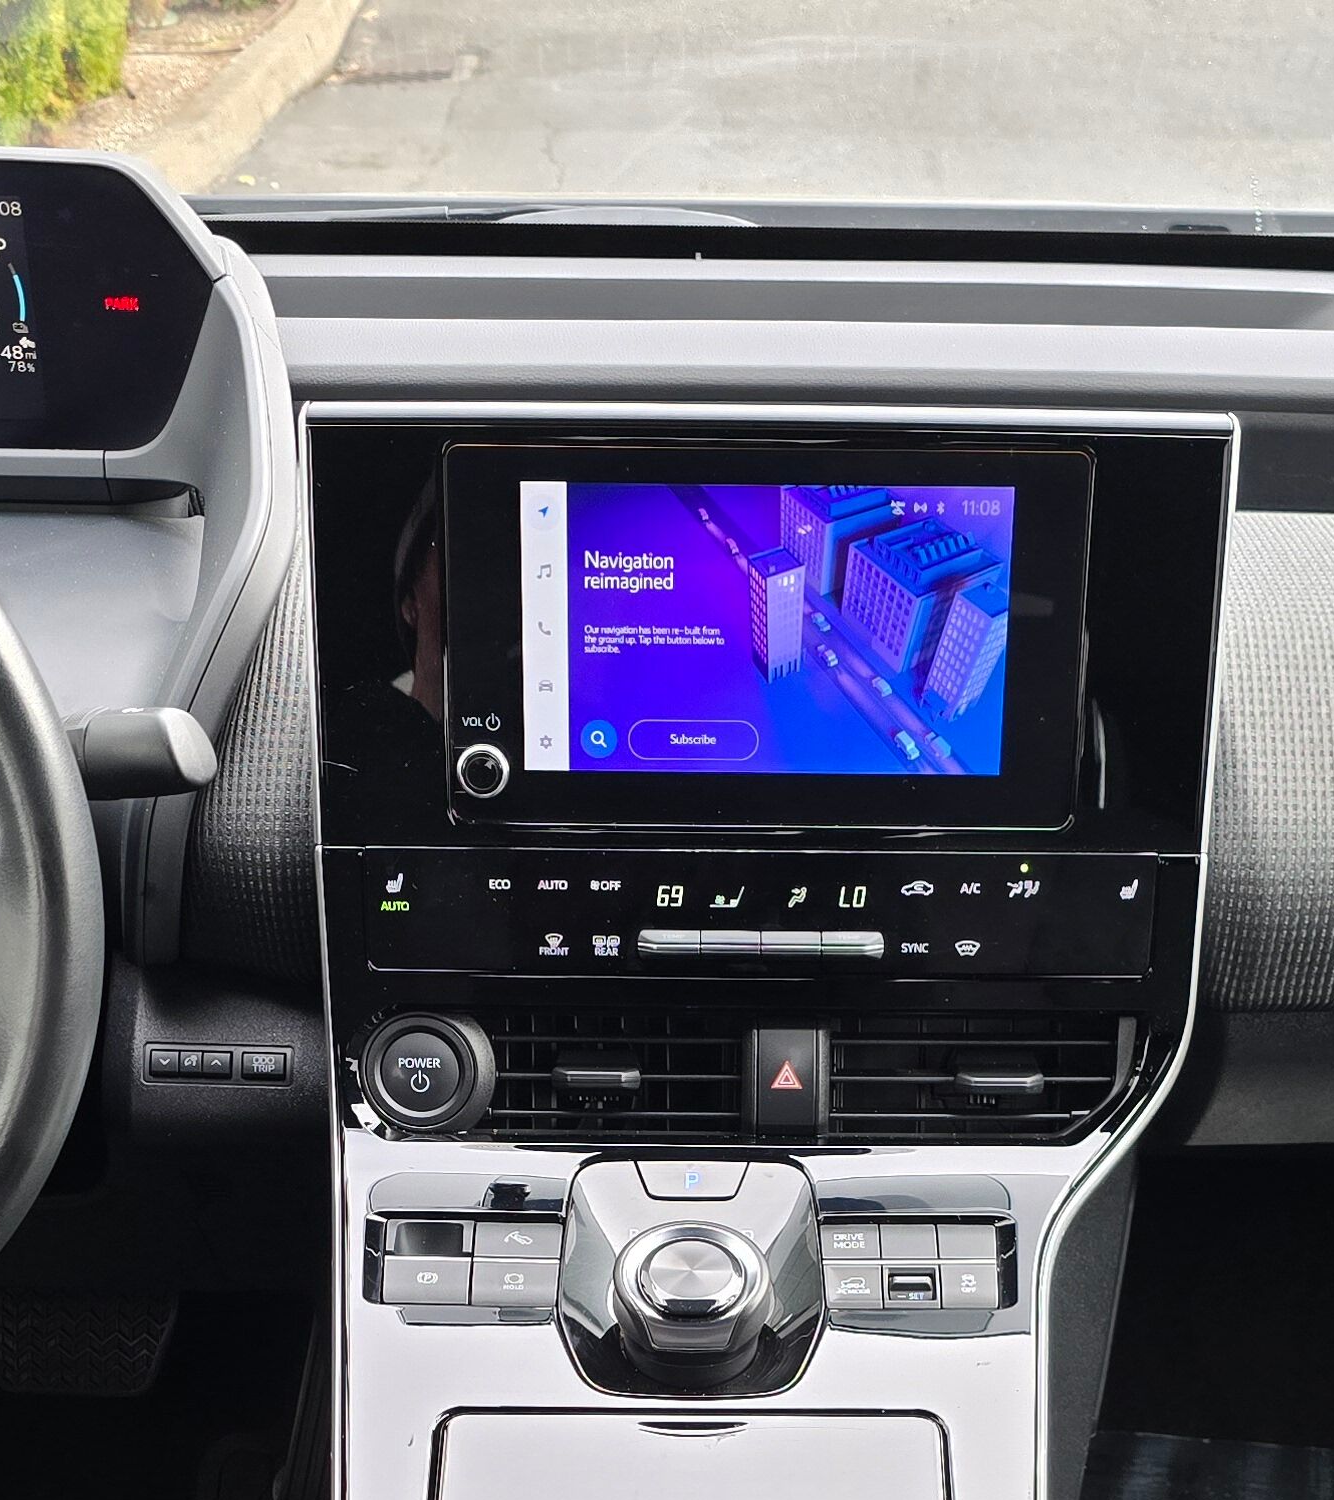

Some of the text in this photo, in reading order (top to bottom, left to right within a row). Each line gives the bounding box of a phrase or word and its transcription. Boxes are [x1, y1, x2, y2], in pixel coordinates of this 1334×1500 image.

[25, 350, 37, 360] mi
[8, 361, 35, 373] 78%
[961, 498, 1001, 517] 11:08
[584, 550, 674, 573] Navigation
[584, 572, 674, 593] reimagined
[584, 625, 720, 637] Our navigation has been re-built from
[584, 635, 725, 646] the ground up. Tap the button below to
[584, 644, 620, 654] subscribe.
[462, 716, 482, 727] VOL
[669, 733, 717, 745] Subscribe
[488, 879, 511, 890] ECO
[537, 880, 568, 891] AUTO
[600, 880, 622, 891] OFF
[960, 881, 981, 896] A/C
[656, 885, 683, 907] 69
[380, 901, 410, 912] AUTO
[539, 946, 569, 956] FRONT
[594, 947, 619, 957] REAR
[901, 942, 929, 955] SYNC
[252, 1056, 275, 1065] ODO
[398, 1057, 441, 1069] POWER
[252, 1064, 275, 1074] TRIP
[684, 1171, 699, 1189] P
[833, 1232, 864, 1241] DRIVE
[833, 1241, 866, 1249] MODE
